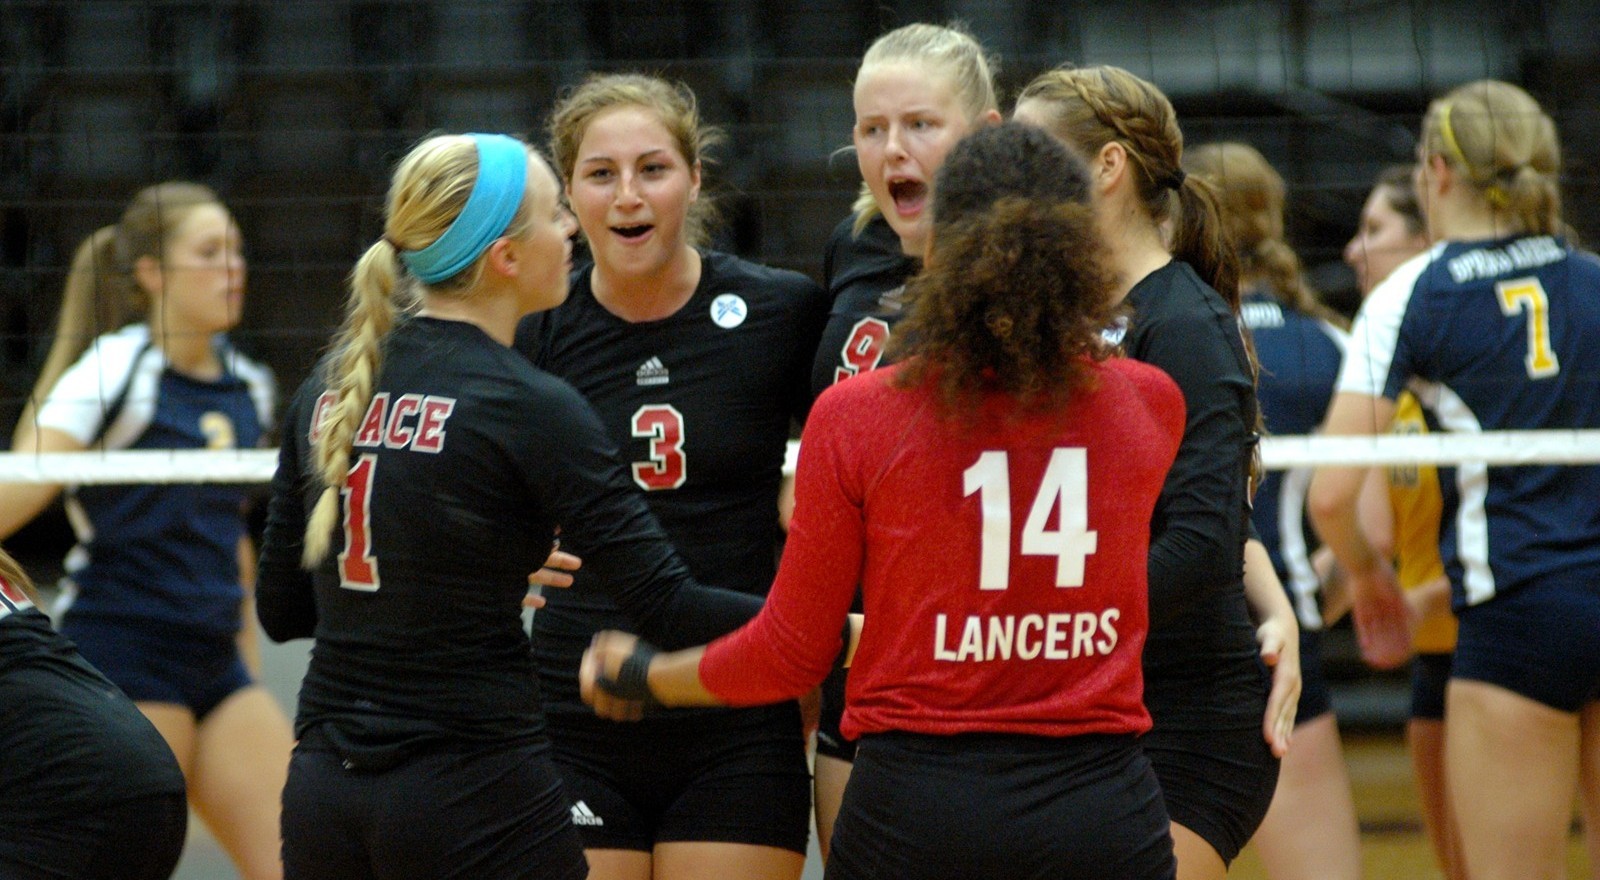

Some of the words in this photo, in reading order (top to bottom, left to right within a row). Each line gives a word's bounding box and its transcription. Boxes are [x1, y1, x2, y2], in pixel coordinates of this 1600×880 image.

[832, 316, 890, 385] 9
[1494, 275, 1560, 380] 7
[308, 389, 457, 453] GACE
[631, 404, 687, 490] 3
[337, 452, 381, 592] 1
[962, 446, 1098, 590] 14
[934, 607, 1121, 663] LANCERS
